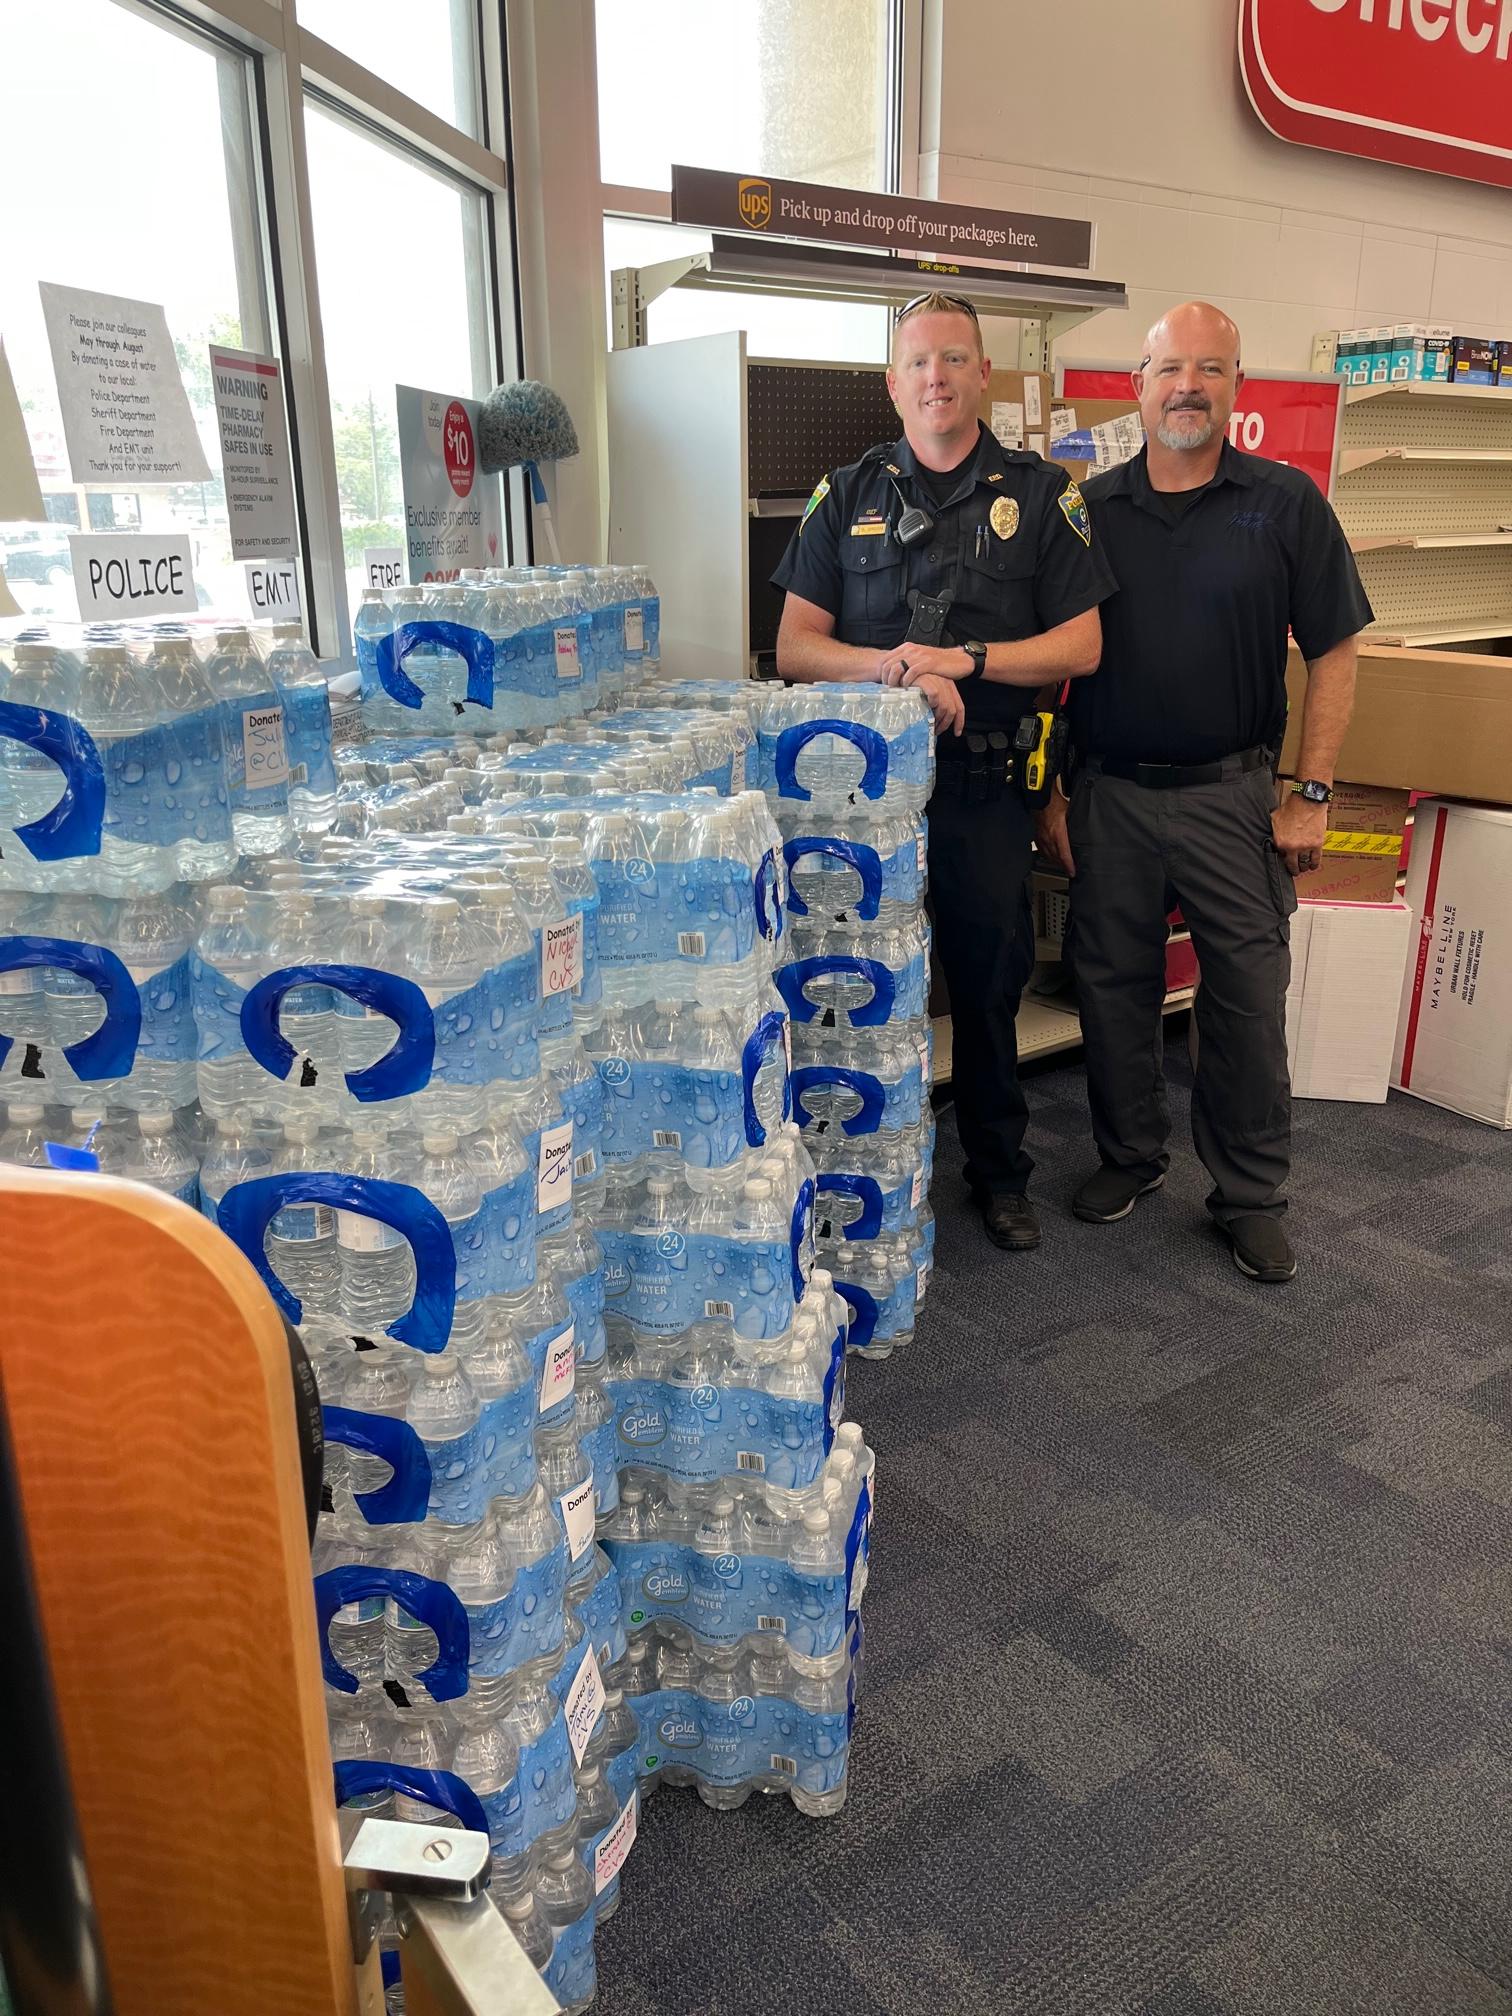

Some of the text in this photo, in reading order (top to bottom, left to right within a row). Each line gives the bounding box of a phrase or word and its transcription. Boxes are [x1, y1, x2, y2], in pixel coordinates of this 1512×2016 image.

[741, 192, 769, 221] ups
[780, 198, 1039, 248] Pick up and drop off your packages here.
[69, 313, 147, 339] Please join our colleagues
[79, 334, 144, 355] May through August
[71, 350, 80, 366] By
[81, 353, 109, 369] donating
[114, 359, 130, 369] case
[131, 358, 139, 370] of
[139, 362, 157, 372] water
[98, 373, 105, 383] to
[107, 375, 119, 385] our
[90, 388, 150, 405] Police Department
[216, 375, 268, 401] WARNING
[91, 407, 157, 423] Sheriff Department
[219, 405, 264, 423] TIME-DELAY
[99, 424, 155, 439] Fire Department
[222, 422, 264, 439] PHARMACY
[1229, 411, 1264, 451] TO
[108, 442, 154, 455] And EMT unit
[223, 439, 273, 456] SAFES IN USE
[447, 424, 469, 466] $10
[88, 459, 182, 474] Thank you for your support!
[407, 505, 481, 527] Exclusive member
[234, 537, 291, 547] FOR SAFETY AND SECURITY
[410, 536, 469, 560] benefits await!
[89, 555, 184, 600] POLICE
[251, 570, 292, 607] EMT
[630, 861, 647, 877] 24
[600, 912, 637, 925] WATER
[1469, 930, 1477, 947] RESET
[1430, 905, 1453, 1009] MAYBELLINE
[1450, 930, 1465, 993] URBAN WALL FIXTURES
[1465, 947, 1474, 974] COSMETIC
[1468, 929, 1484, 1006] FRAGILE HANDLE WITH CARE
[1461, 986, 1469, 1001] HOLD
[606, 1061, 624, 1077] 24
[662, 1235, 679, 1251] 24
[604, 1264, 625, 1281] old
[635, 1284, 667, 1295] WATER
[697, 1388, 714, 1404] 24
[622, 1412, 661, 1438] Gold
[637, 1428, 664, 1436] emblem
[670, 1432, 700, 1445] WATER
[719, 1557, 735, 1572] 24
[647, 1574, 684, 1596] Gold
[693, 1595, 722, 1610] WATER
[735, 1699, 749, 1716] 24
[661, 1720, 697, 1742] Gold
[706, 1743, 737, 1753] WATER
